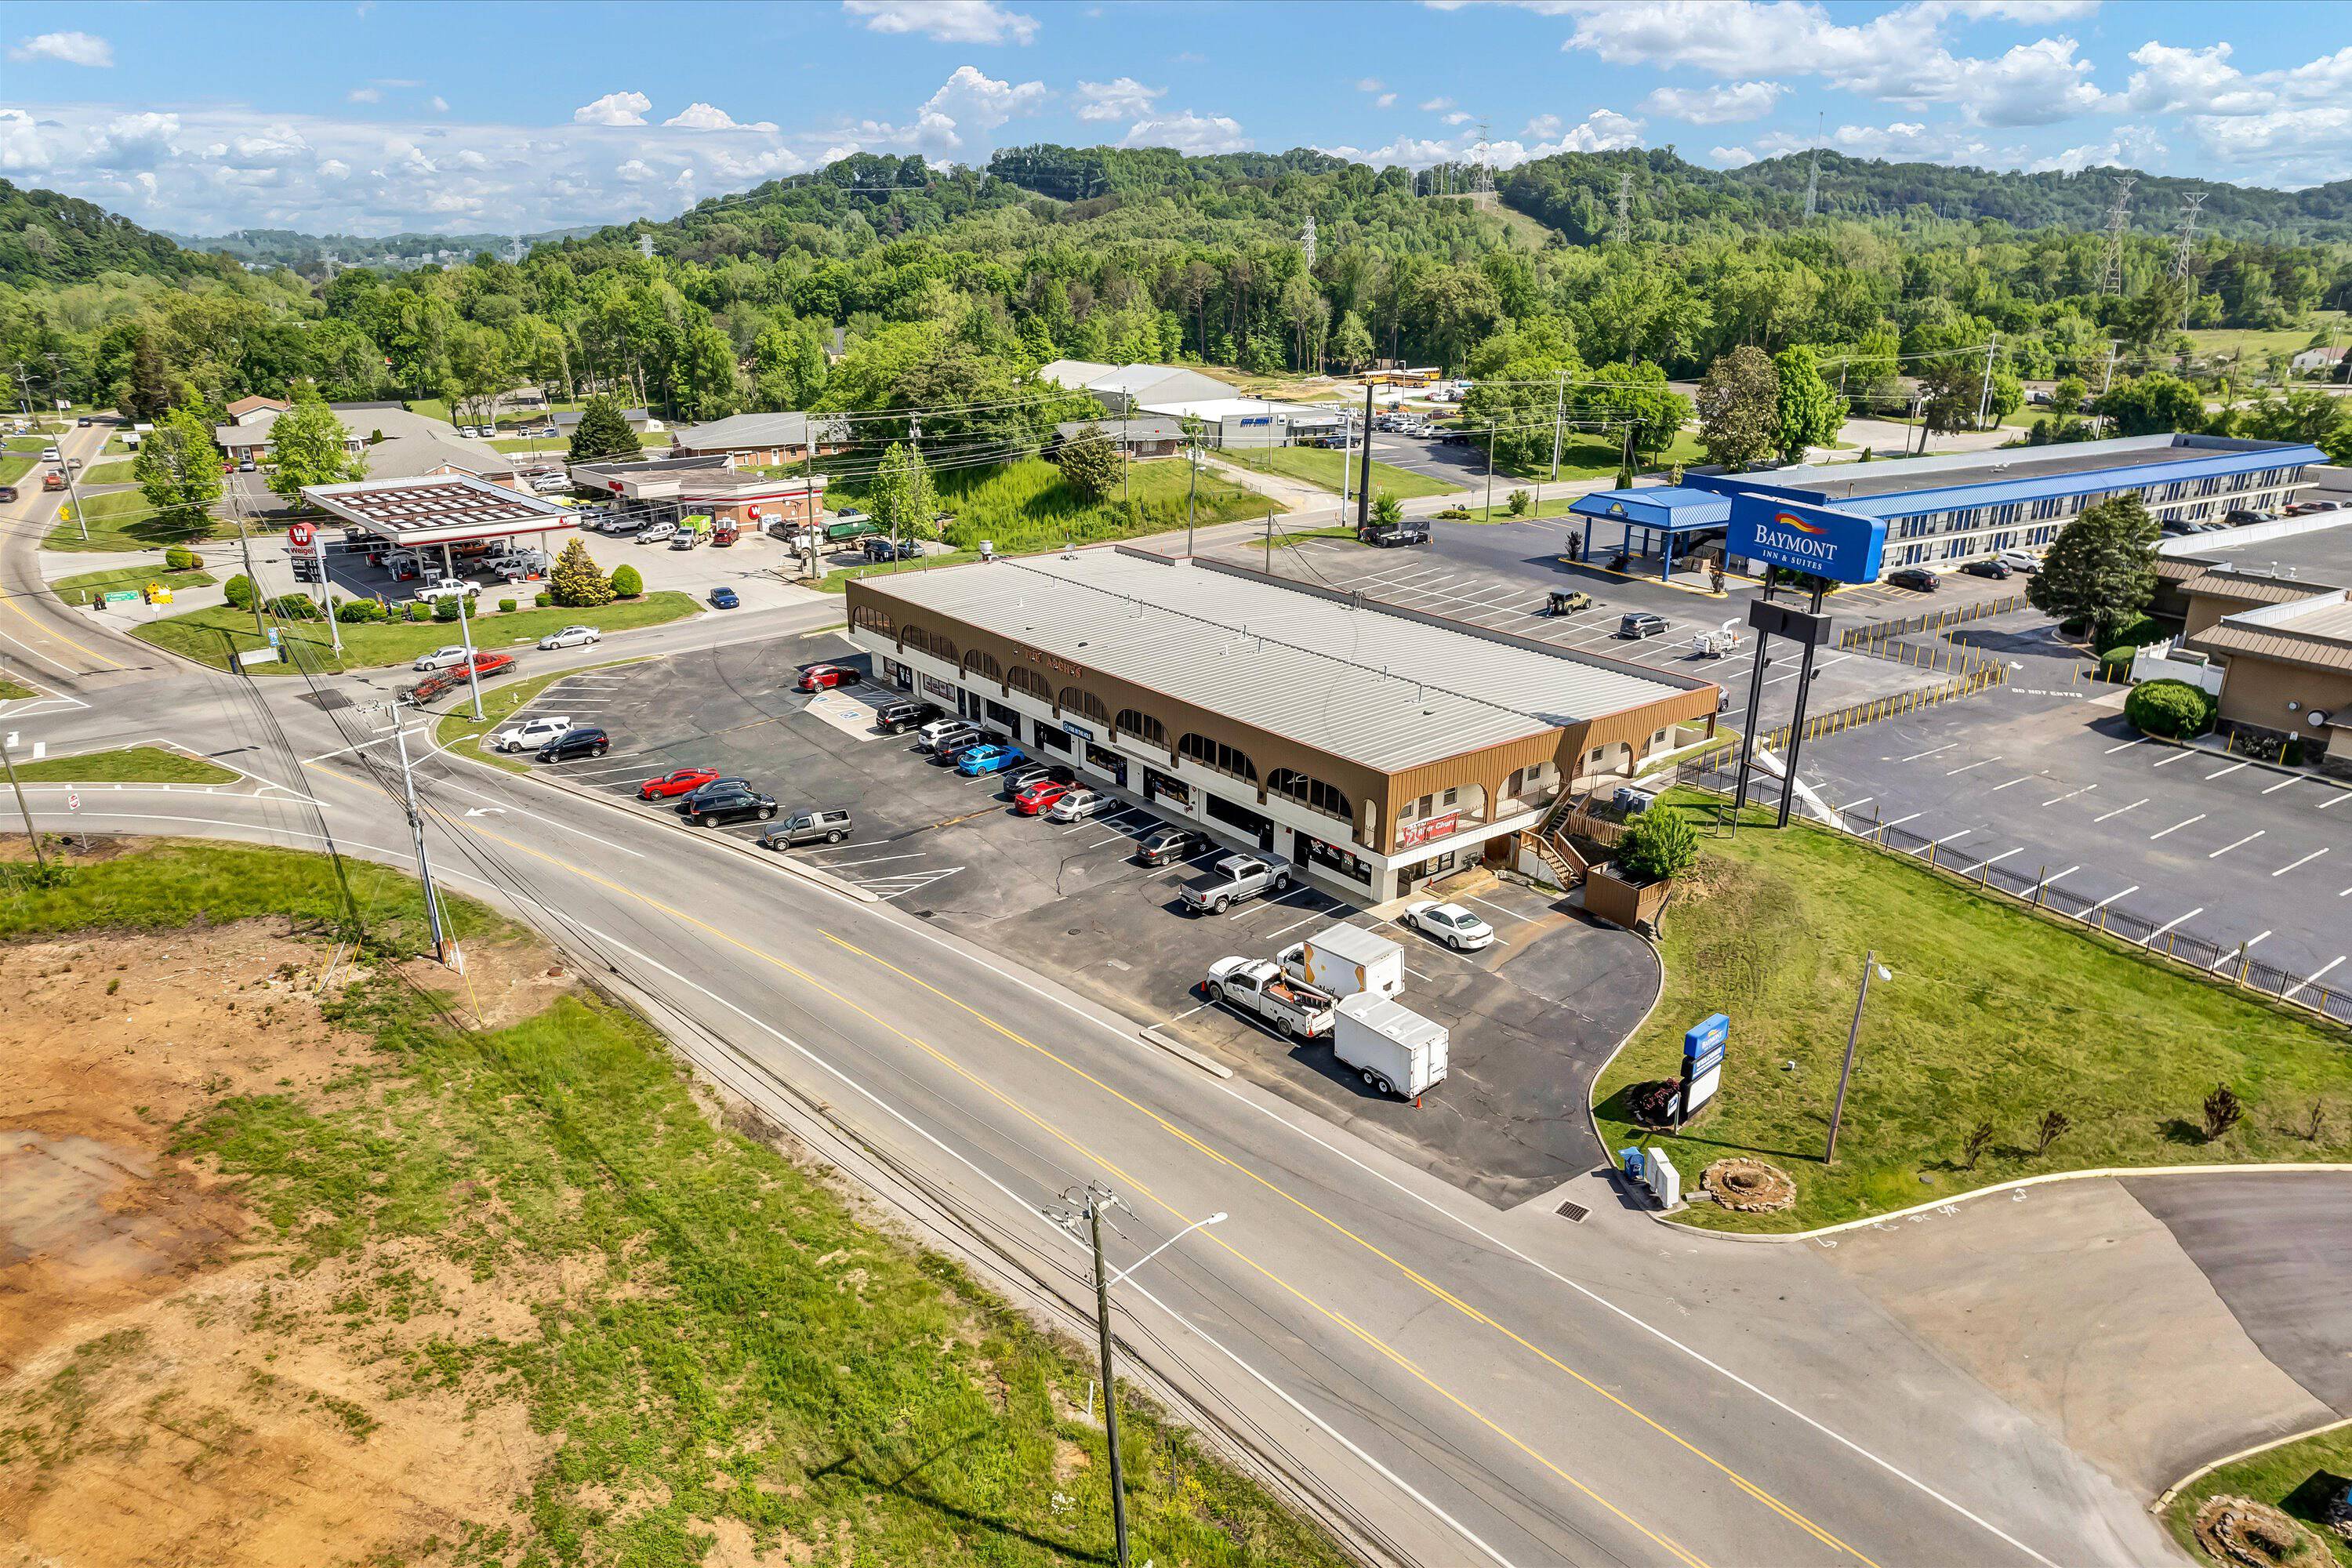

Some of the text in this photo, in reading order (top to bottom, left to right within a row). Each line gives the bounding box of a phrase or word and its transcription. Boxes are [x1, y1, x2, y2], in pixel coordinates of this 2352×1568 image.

[751, 506, 761, 516] W
[293, 528, 307, 542] W
[1754, 524, 1837, 561] BAYMONT
[1762, 550, 1778, 560] INN
[1791, 556, 1823, 571] SUITES
